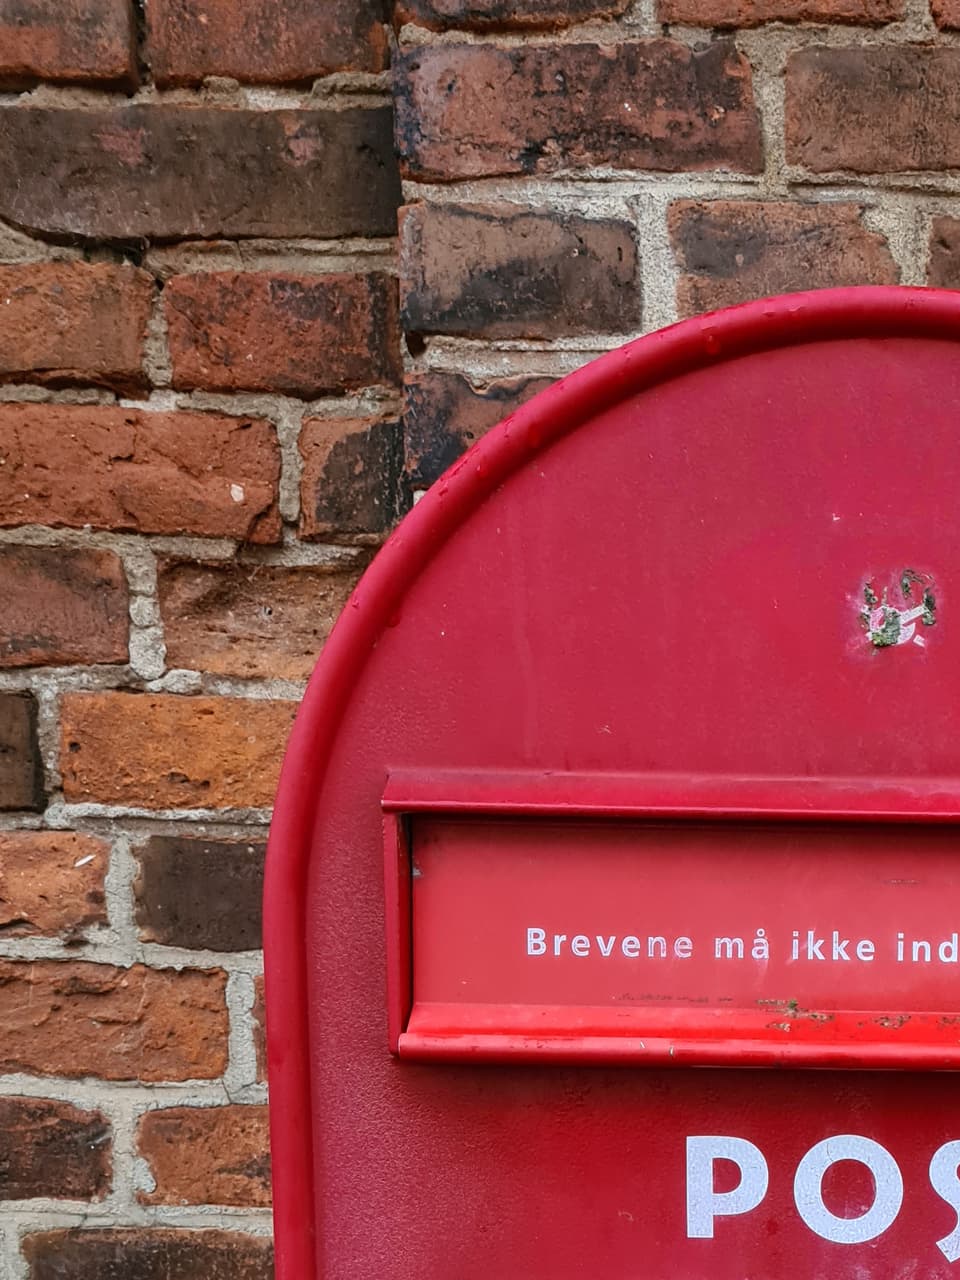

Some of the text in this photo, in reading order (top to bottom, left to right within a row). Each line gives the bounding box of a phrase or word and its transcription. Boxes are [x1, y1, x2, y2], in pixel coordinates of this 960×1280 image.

[526, 927, 694, 958] Brevene
[714, 928, 770, 960] må
[791, 930, 876, 961] ikke
